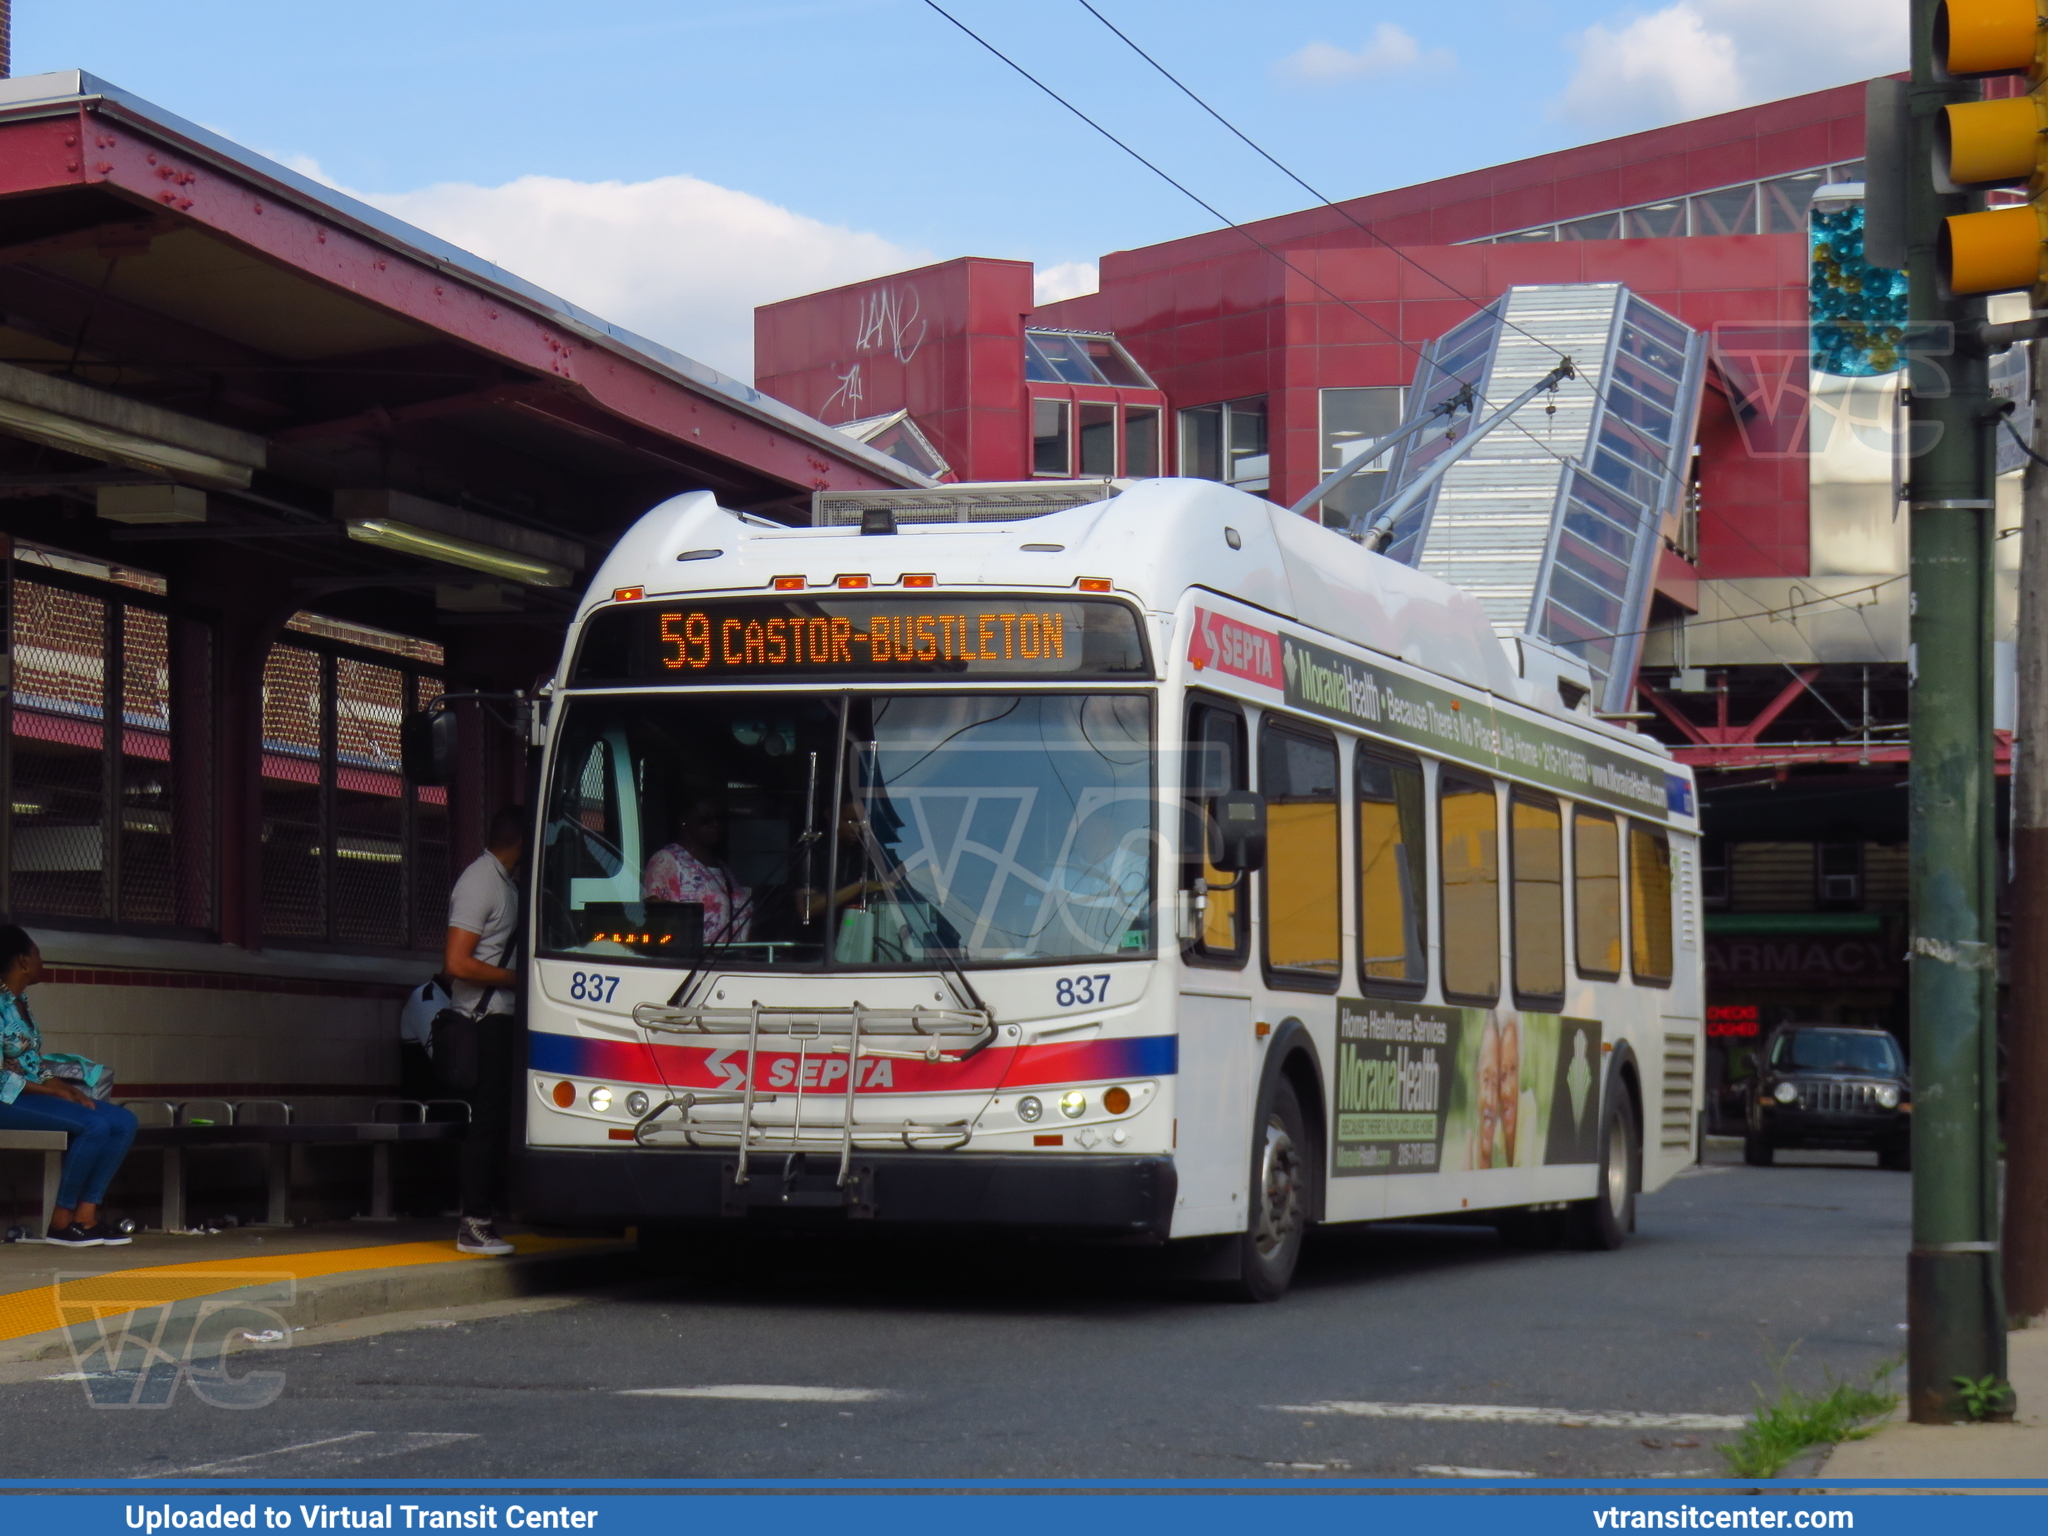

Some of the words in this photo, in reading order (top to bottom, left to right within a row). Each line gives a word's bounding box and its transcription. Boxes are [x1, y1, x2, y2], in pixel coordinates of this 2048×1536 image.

[661, 613, 711, 669] 59
[722, 612, 1064, 665] CASTOR-BUSTLETON
[1222, 623, 1273, 679] SEPTA
[1298, 648, 1382, 722] MoraviaHealth
[1386, 686, 1428, 732] Because
[1426, 701, 1460, 742] There's
[1459, 712, 1473, 746] No
[1514, 732, 1539, 767] Home
[569, 971, 621, 1004] 837
[1055, 974, 1112, 1008] 837
[1341, 1008, 1368, 1038] Home
[1369, 1010, 1413, 1042] Healthcare
[1413, 1014, 1447, 1044] Services
[768, 1058, 894, 1088] SEPTA
[1338, 1043, 1440, 1112] MoraviaHealth
